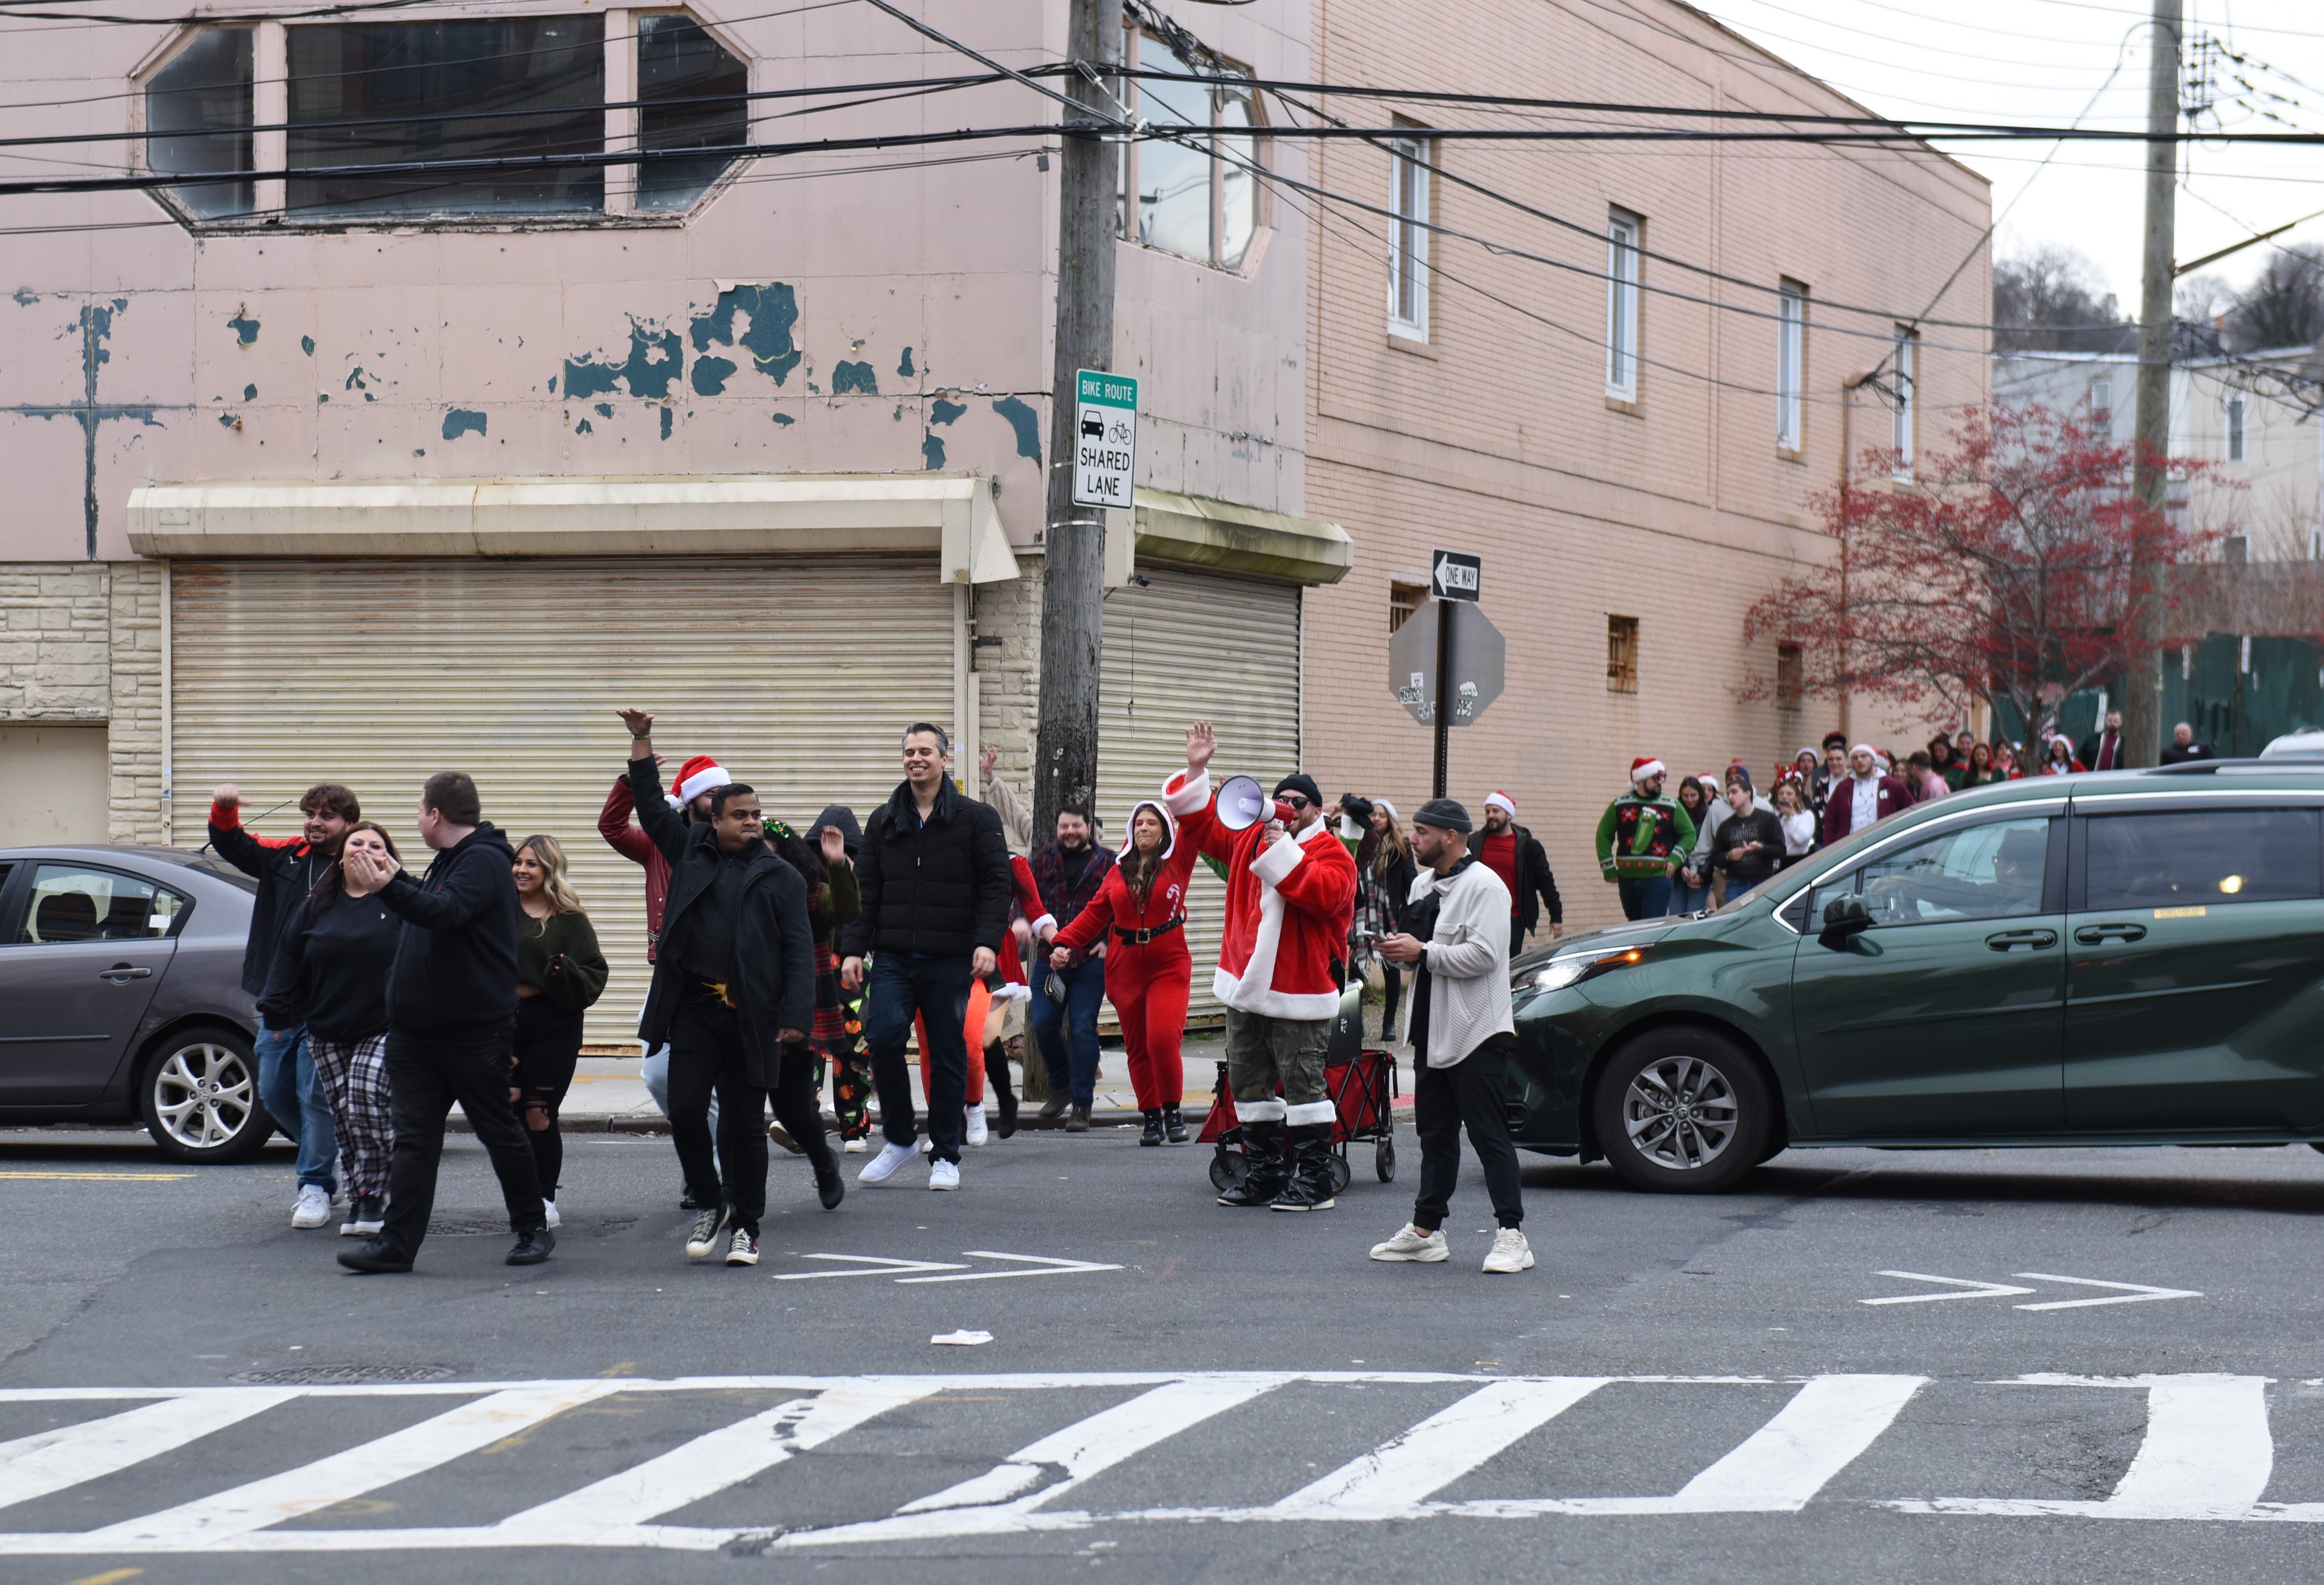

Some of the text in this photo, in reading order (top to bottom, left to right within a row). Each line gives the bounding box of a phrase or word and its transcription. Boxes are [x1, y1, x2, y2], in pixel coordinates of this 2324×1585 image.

[1082, 380, 1133, 402] BIKE ROUTE
[1080, 447, 1130, 471] SHARED
[1087, 474, 1120, 496] LANE
[1445, 566, 1475, 588] ONE WAY
